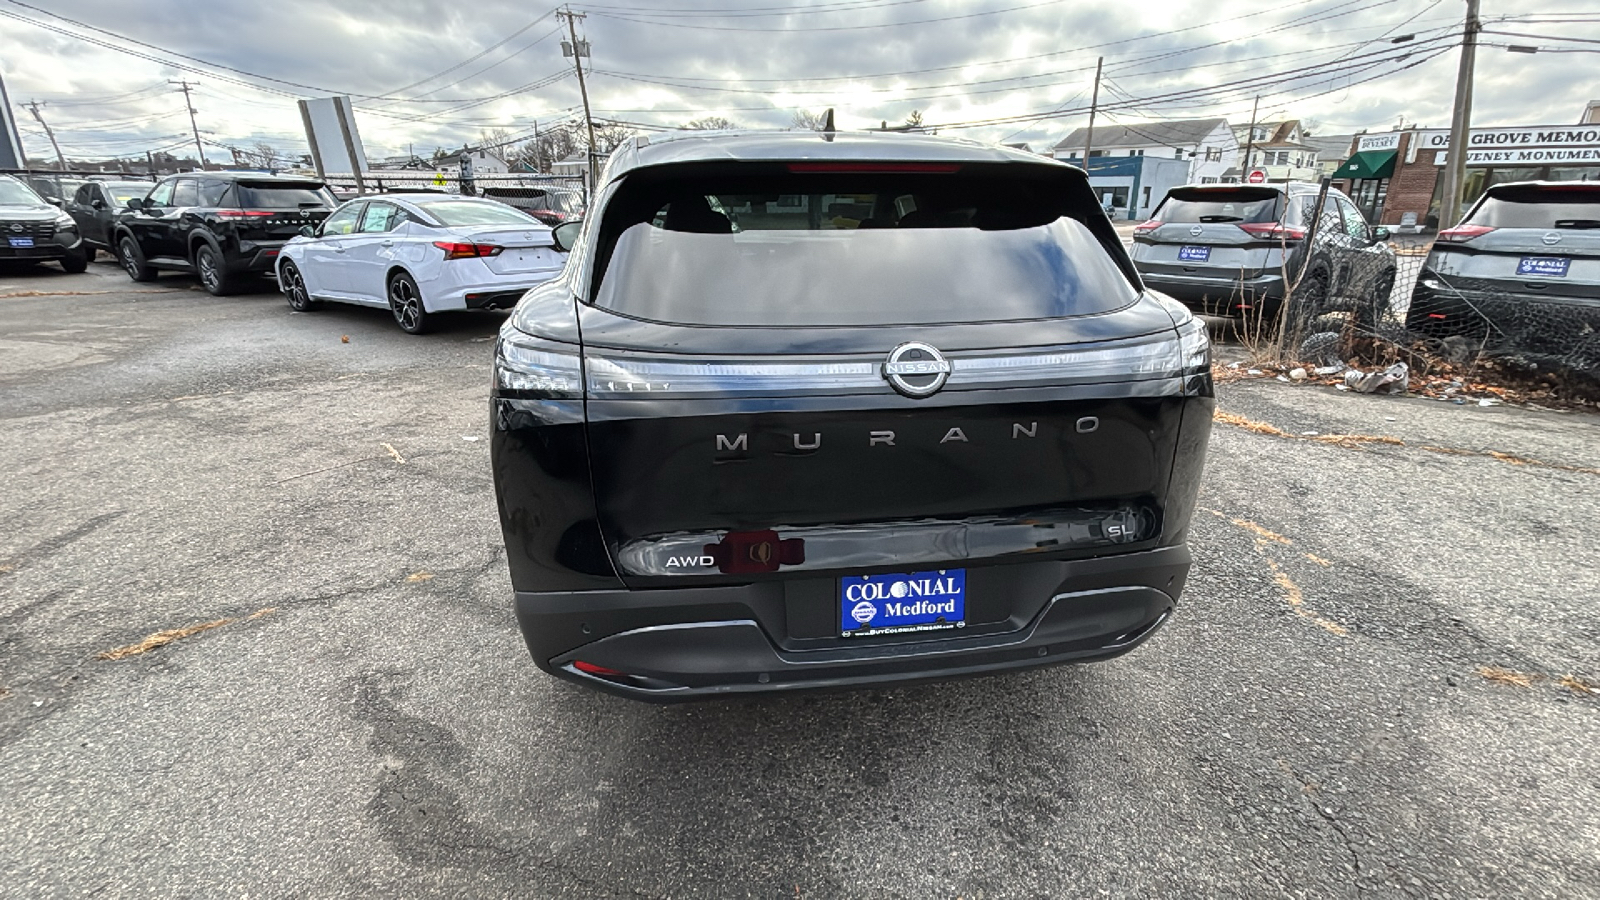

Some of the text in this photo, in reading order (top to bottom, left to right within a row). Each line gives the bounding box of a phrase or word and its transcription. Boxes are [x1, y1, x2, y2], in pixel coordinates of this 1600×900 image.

[1431, 134, 1451, 146] OA
[1471, 132, 1533, 145] GROVE
[1443, 150, 1514, 162] VENEY
[887, 362, 948, 374] NISSAN
[715, 415, 1100, 452] MURANO
[1107, 524, 1134, 538] SL
[665, 556, 715, 568] AWD
[846, 577, 961, 602] COLONIAL
[884, 598, 955, 618] Medford
